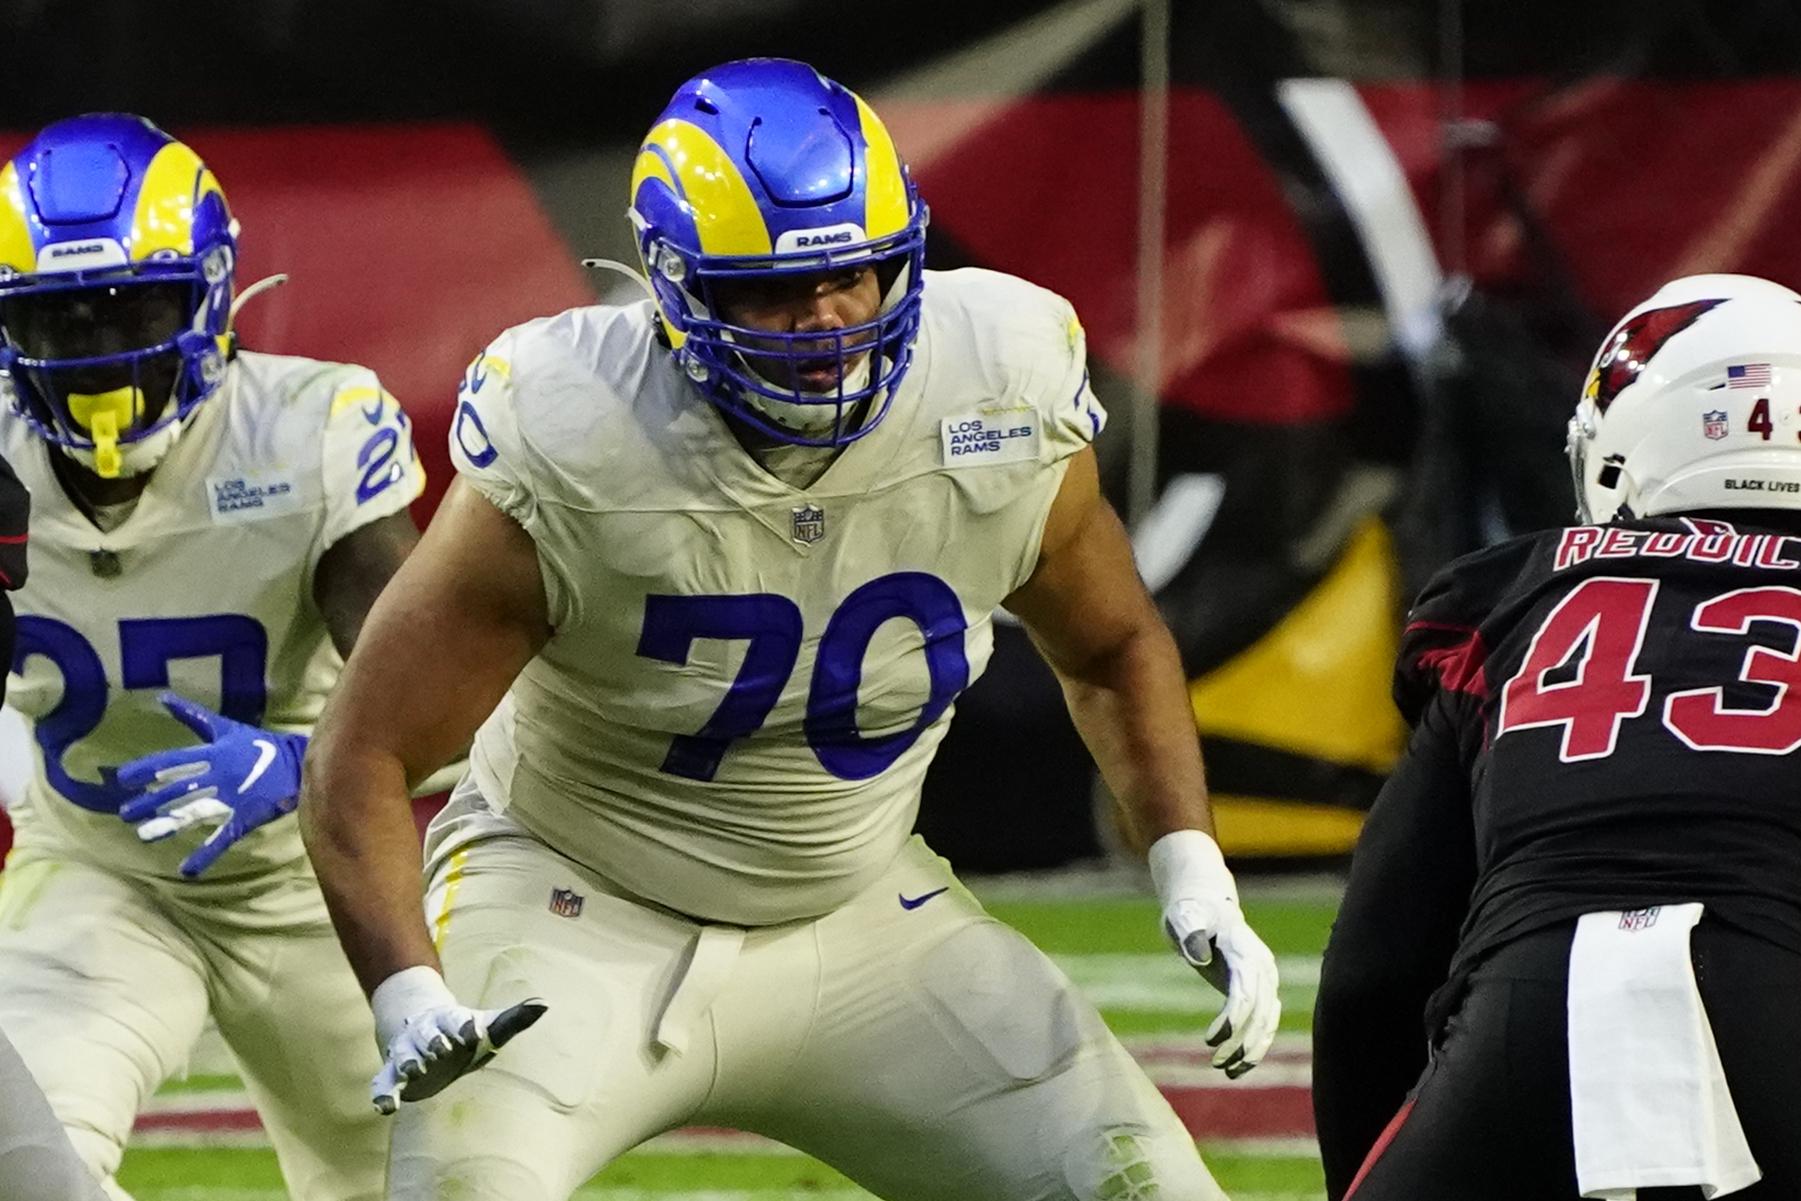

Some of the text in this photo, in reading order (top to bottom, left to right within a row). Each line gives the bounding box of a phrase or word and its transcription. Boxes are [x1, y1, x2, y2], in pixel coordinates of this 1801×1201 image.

[796, 231, 852, 248] RAMS
[948, 419, 983, 434] LOS
[950, 426, 1033, 446] ANGELES
[950, 441, 1002, 457] RAMS
[1724, 479, 1801, 493] BLACK LIVES
[635, 571, 970, 782] 70
[1496, 576, 1801, 763] 43
